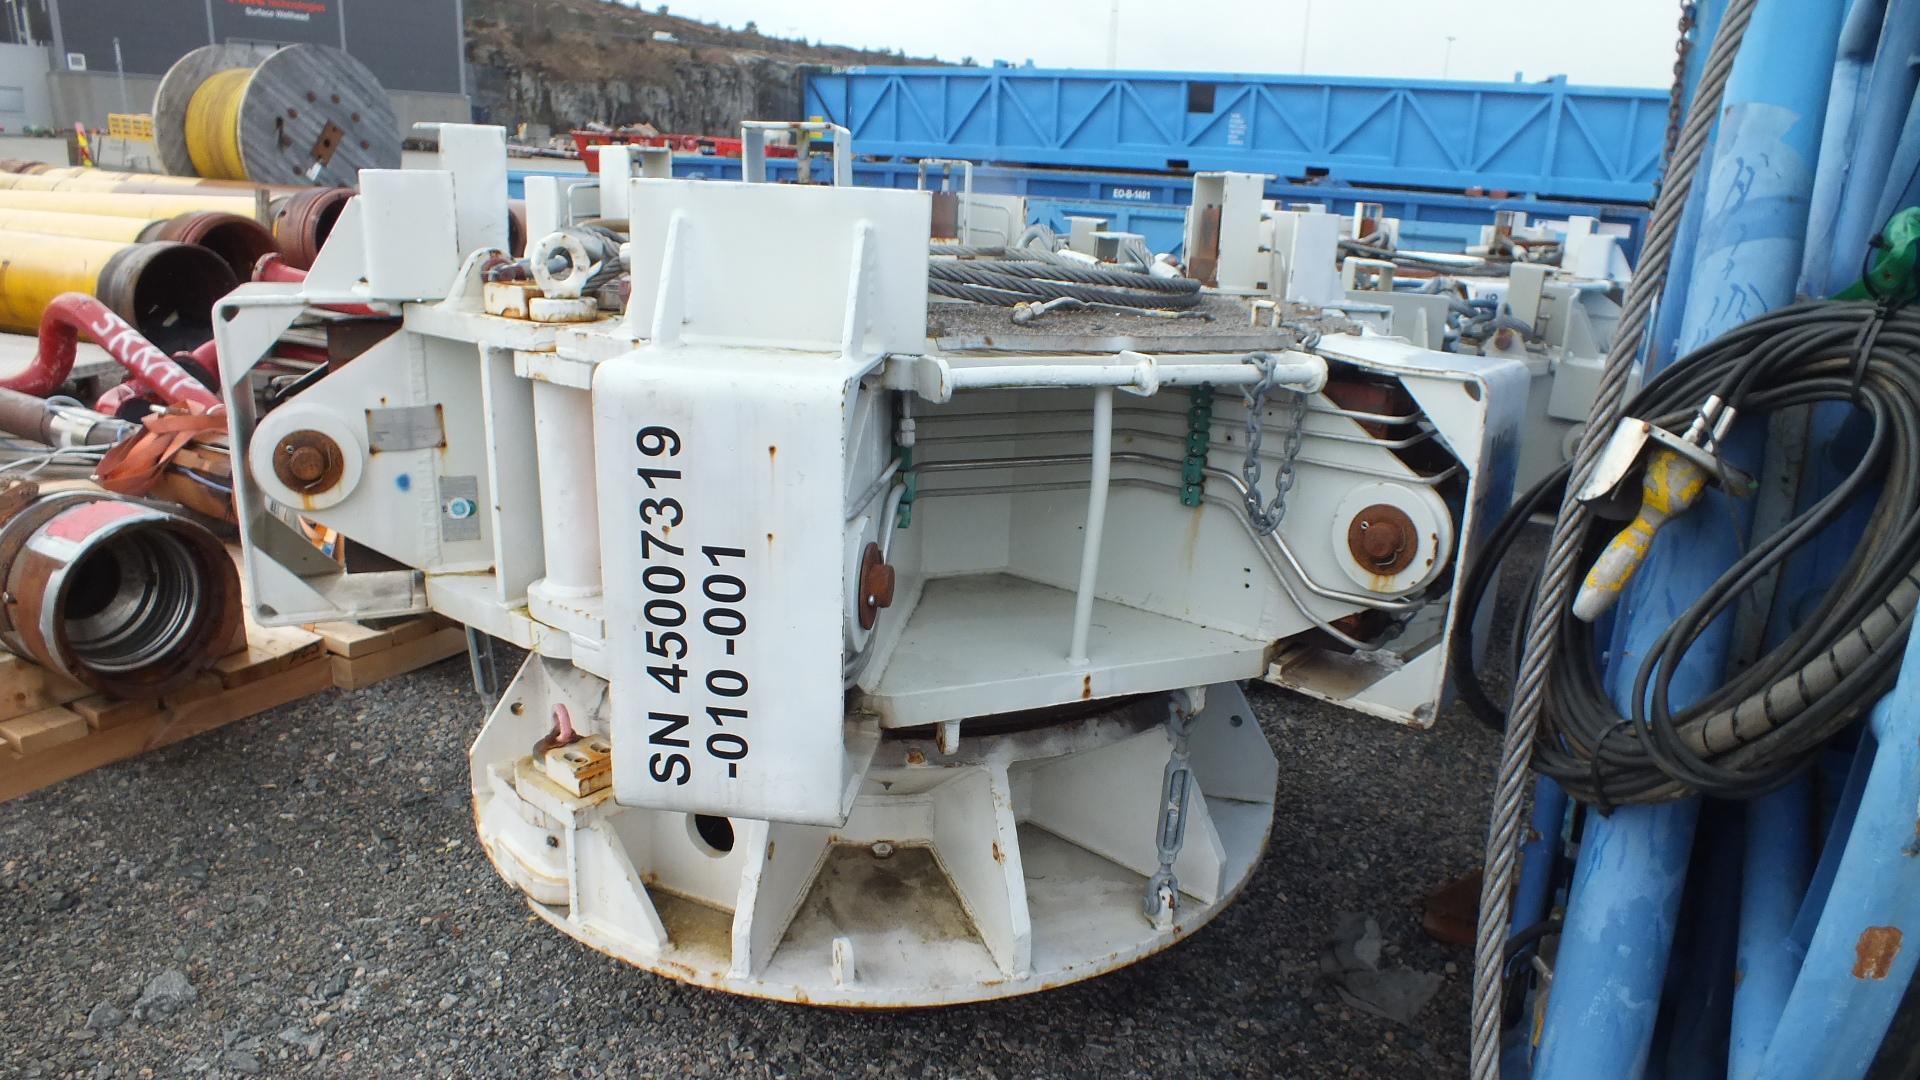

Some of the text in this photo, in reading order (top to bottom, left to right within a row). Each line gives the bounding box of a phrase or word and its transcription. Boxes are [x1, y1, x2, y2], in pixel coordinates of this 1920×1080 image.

[245, 6, 274, 17] Surface
[636, 426, 691, 786] SN 45007319
